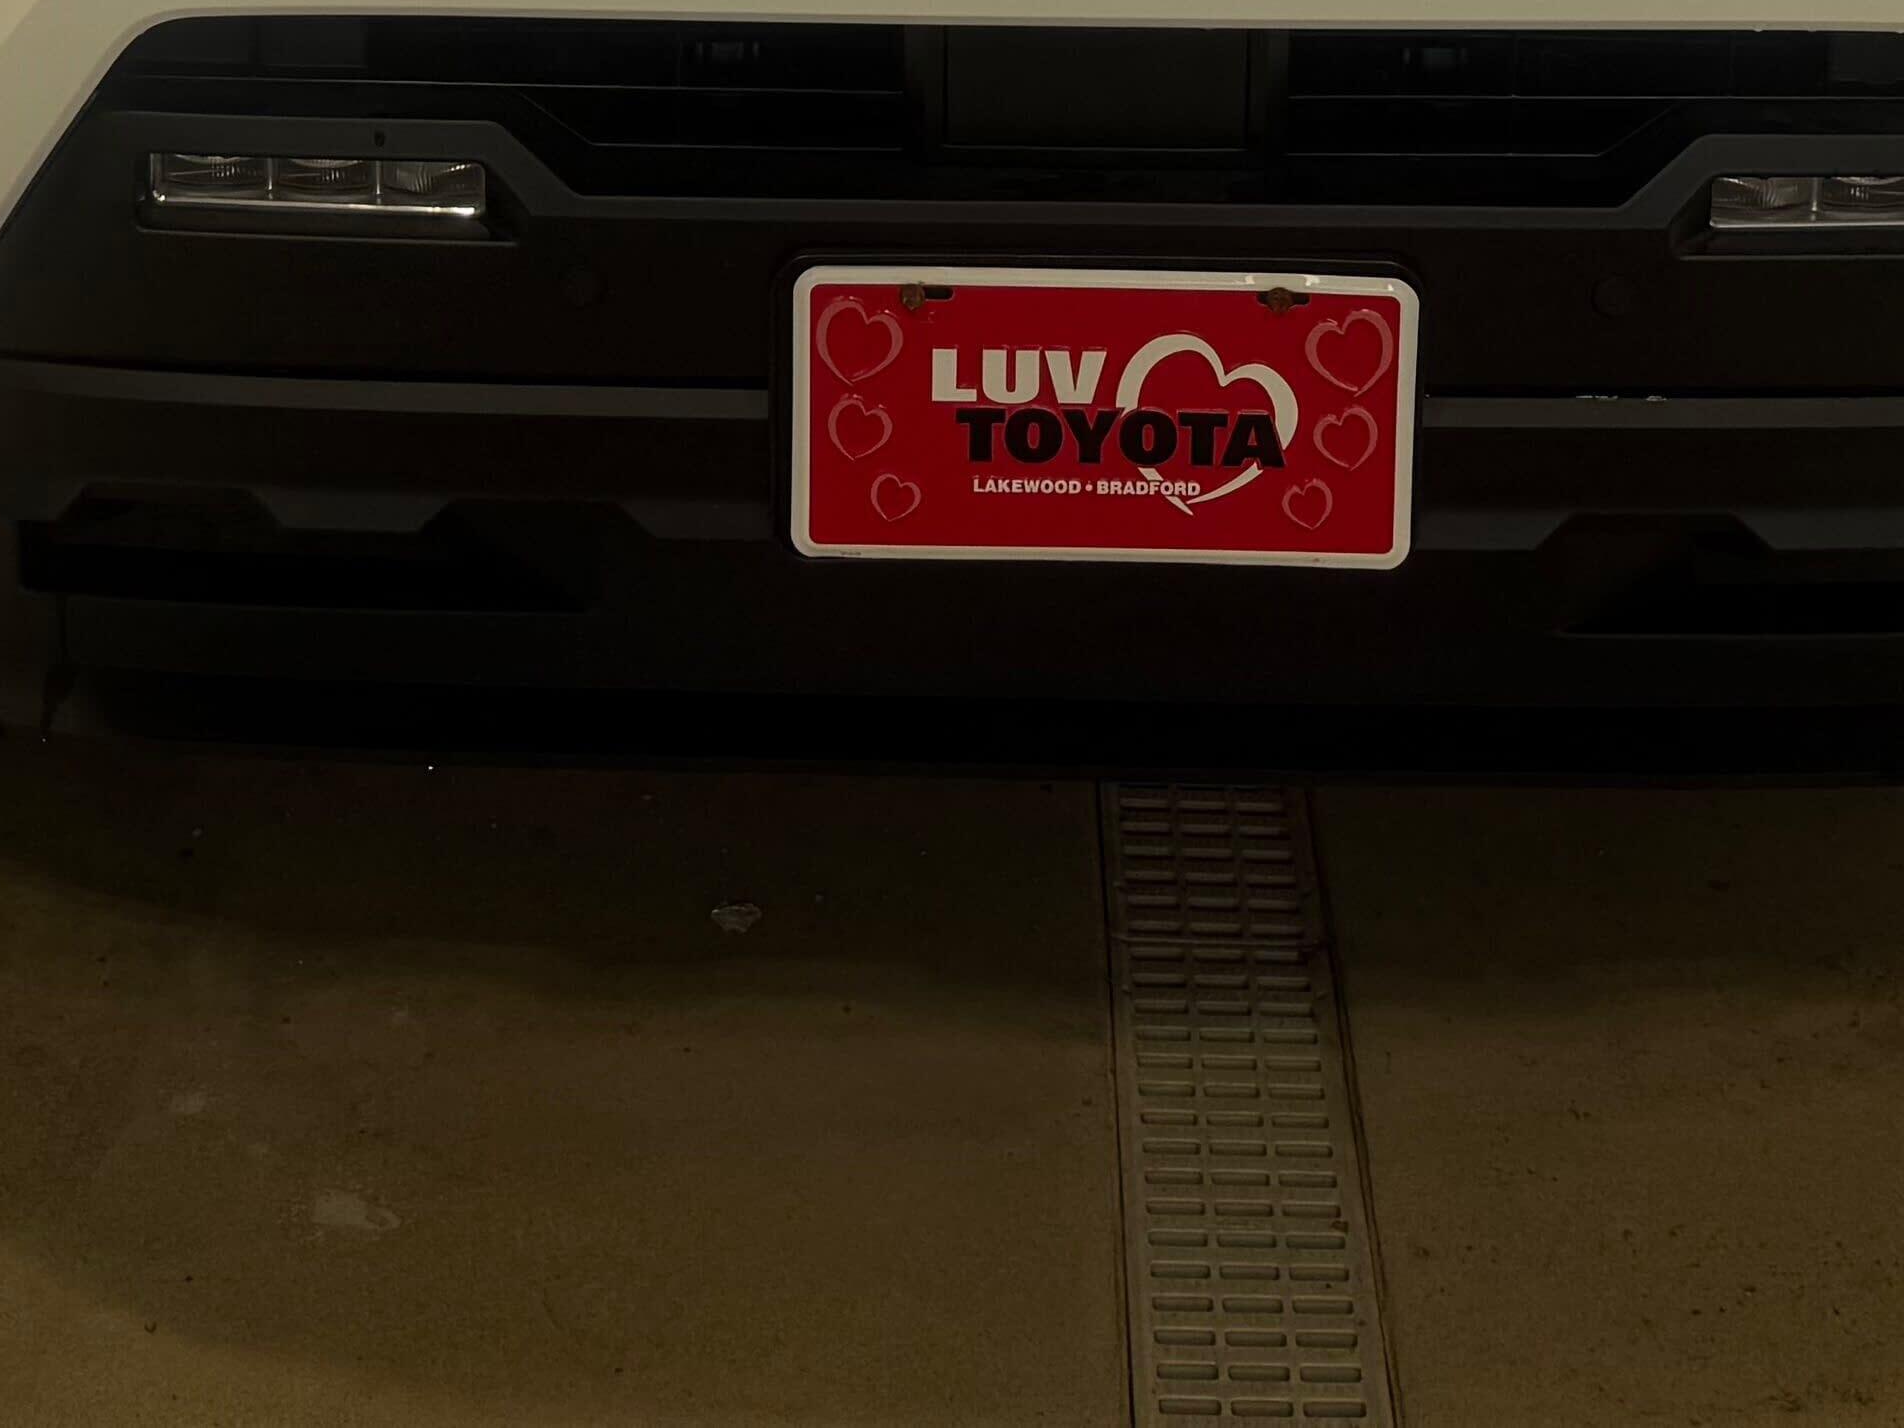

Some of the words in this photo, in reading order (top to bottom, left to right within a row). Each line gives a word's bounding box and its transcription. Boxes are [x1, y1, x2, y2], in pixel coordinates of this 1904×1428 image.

[931, 347, 1108, 405] LUV
[955, 405, 1286, 469] TOYOTA
[972, 476, 1082, 494] LAKEWOOD
[1096, 479, 1201, 497] BRADFORD
